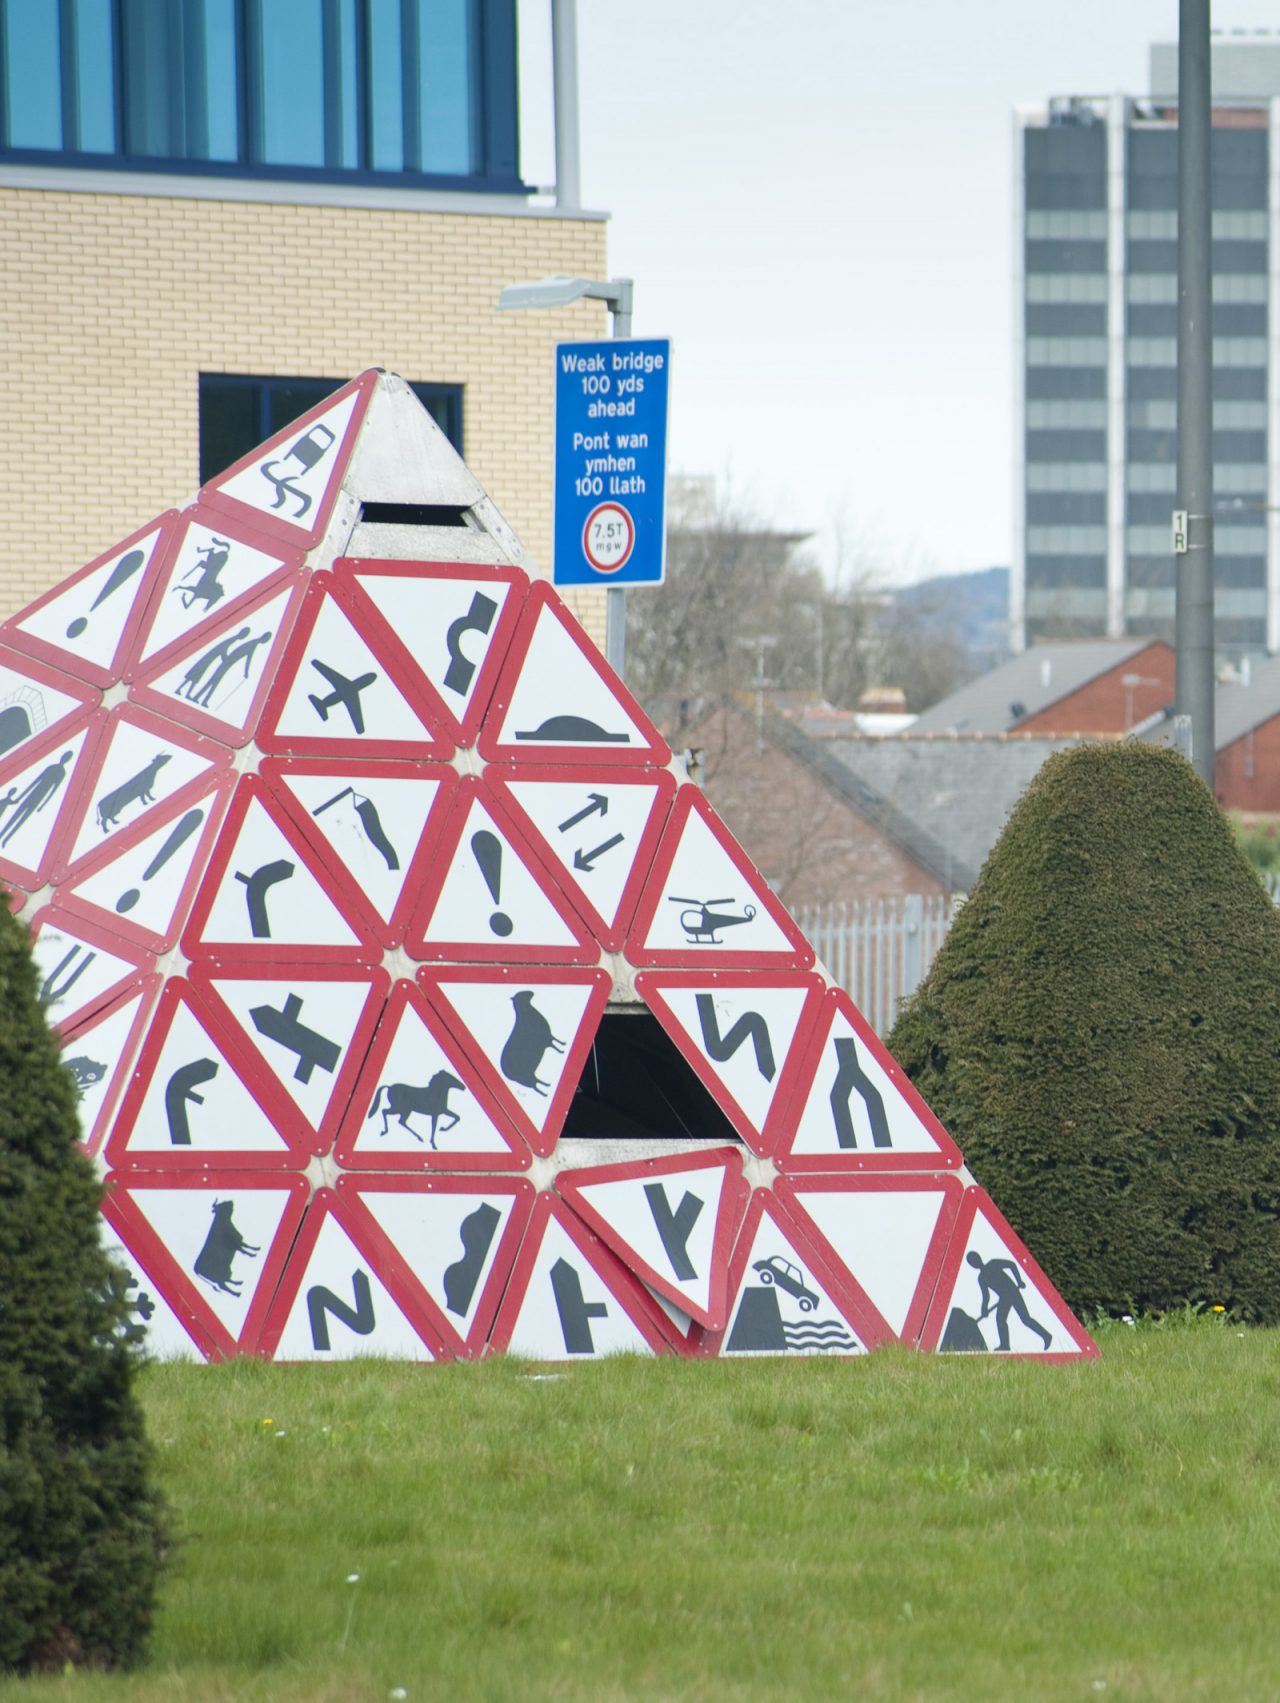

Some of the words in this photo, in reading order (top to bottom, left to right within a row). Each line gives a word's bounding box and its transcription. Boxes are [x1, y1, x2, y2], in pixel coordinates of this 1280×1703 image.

[561, 353, 606, 374] Weak
[611, 351, 664, 374] bridge
[581, 375, 611, 395] 100
[617, 375, 645, 397] yds
[587, 397, 636, 418] ahead
[573, 431, 610, 451] Pont
[616, 433, 649, 449] wan
[584, 455, 636, 476] ymhen
[575, 476, 604, 497] 100
[609, 474, 646, 495] llath
[594, 523, 623, 539] 7.5T
